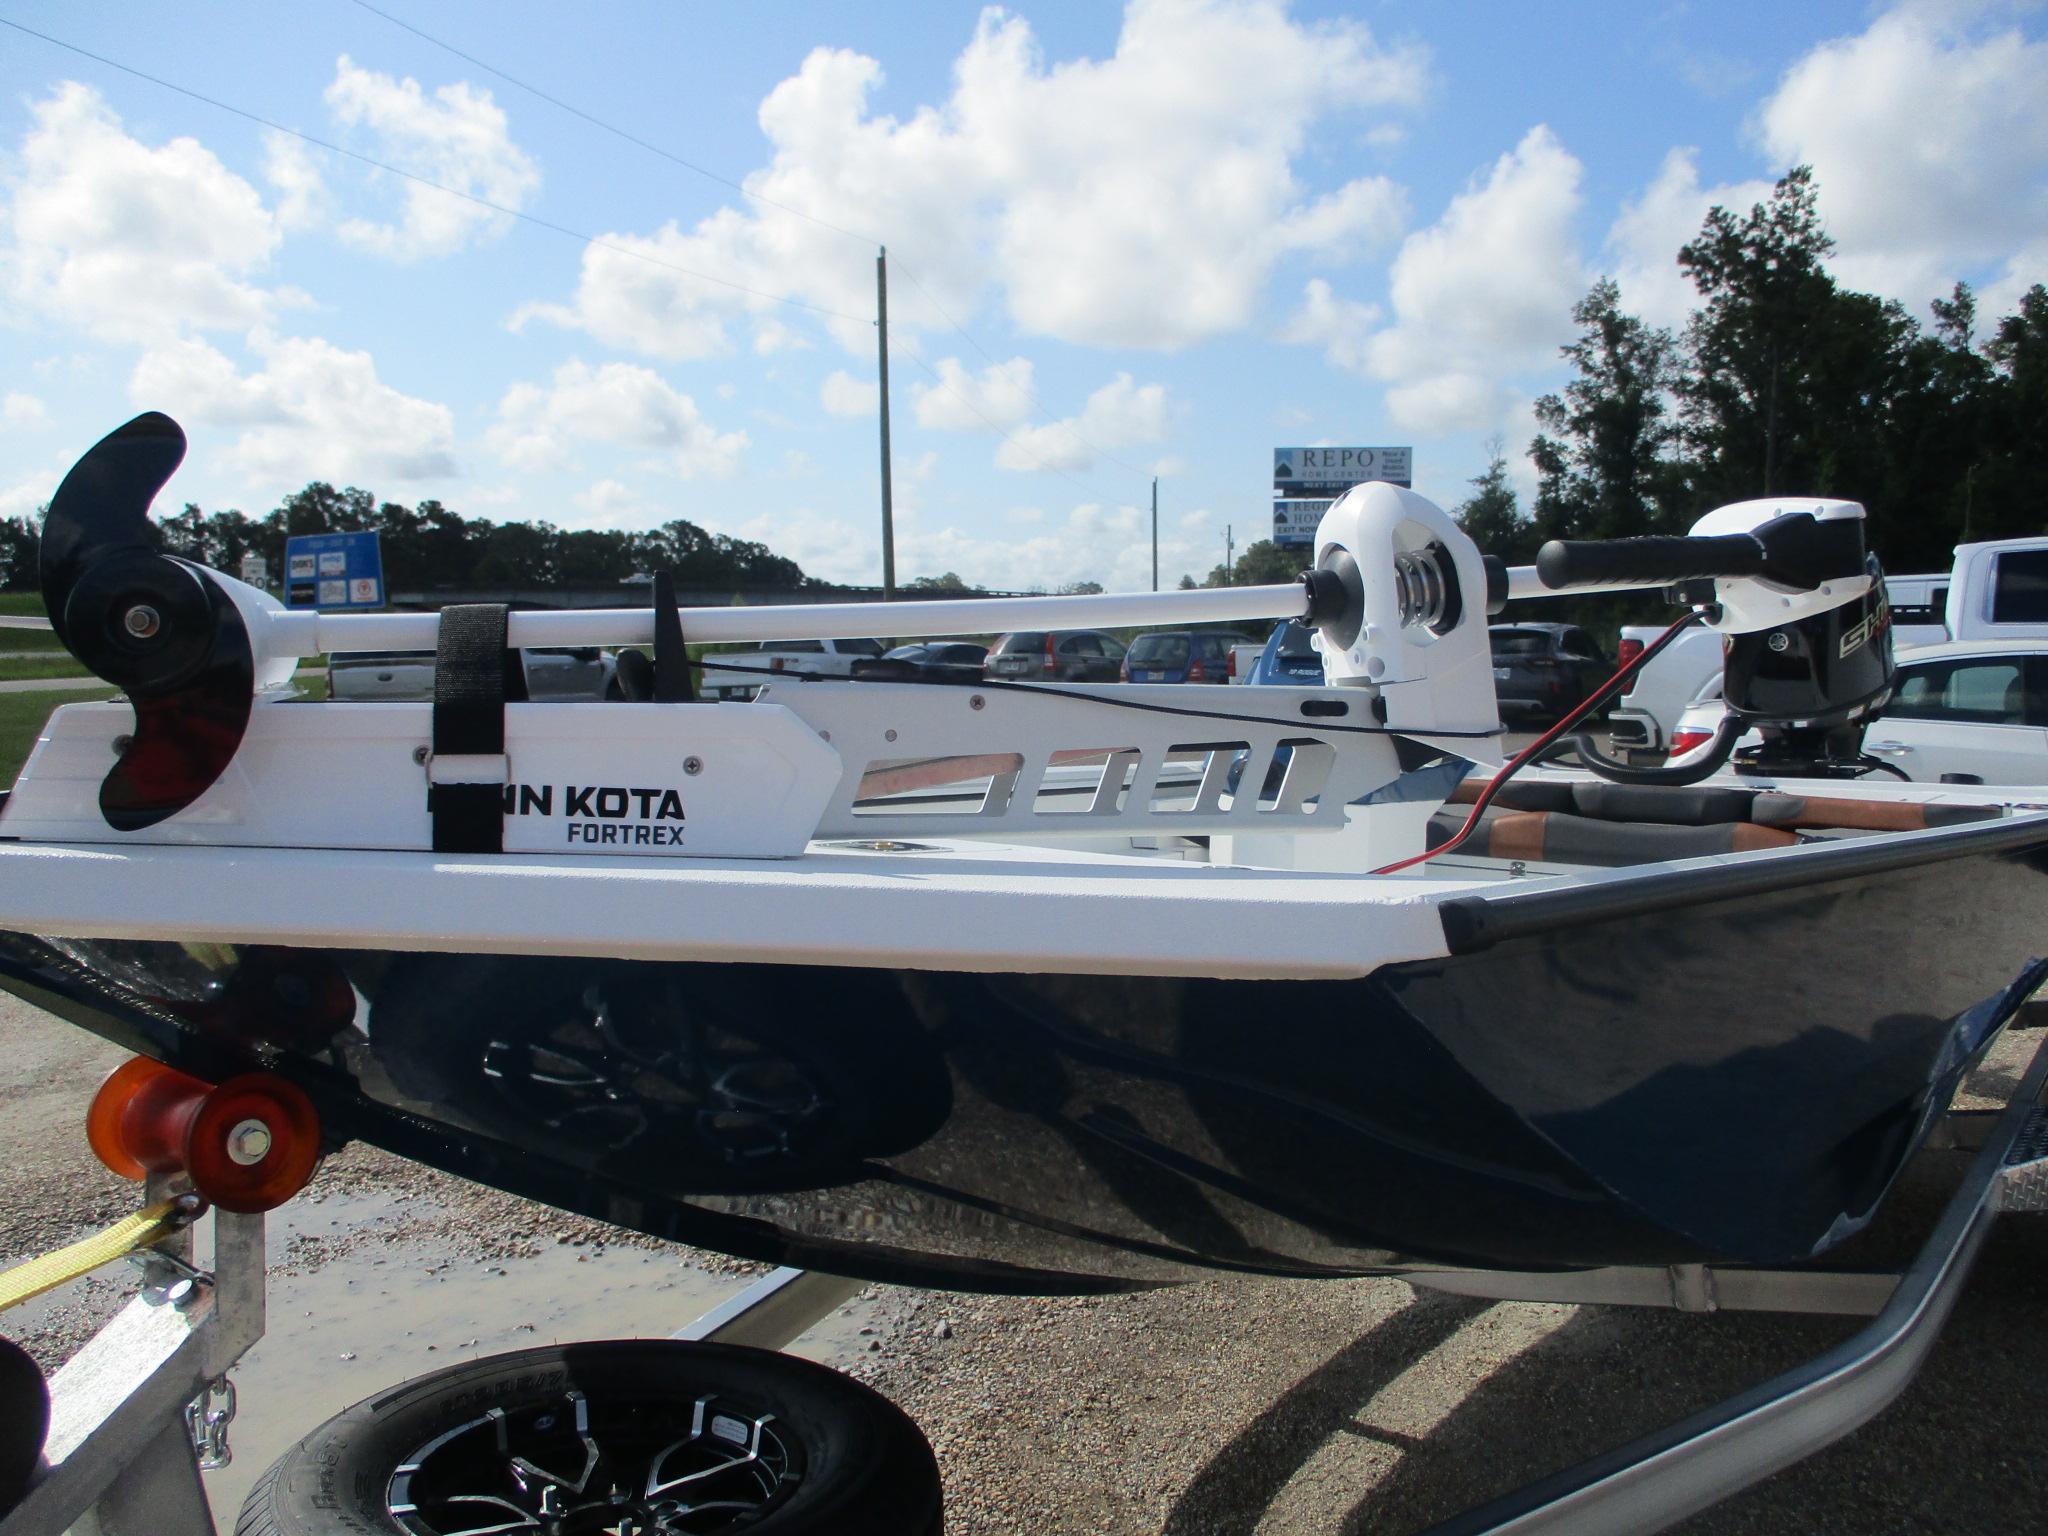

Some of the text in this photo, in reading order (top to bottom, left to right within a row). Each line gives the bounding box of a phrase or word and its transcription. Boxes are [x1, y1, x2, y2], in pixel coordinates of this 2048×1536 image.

[1303, 449, 1374, 467] REPO
[1302, 470, 1373, 478] HOME CENTER
[1277, 526, 1296, 534] EXIT
[565, 785, 686, 820] KOTA
[567, 823, 685, 846] FORTREX
